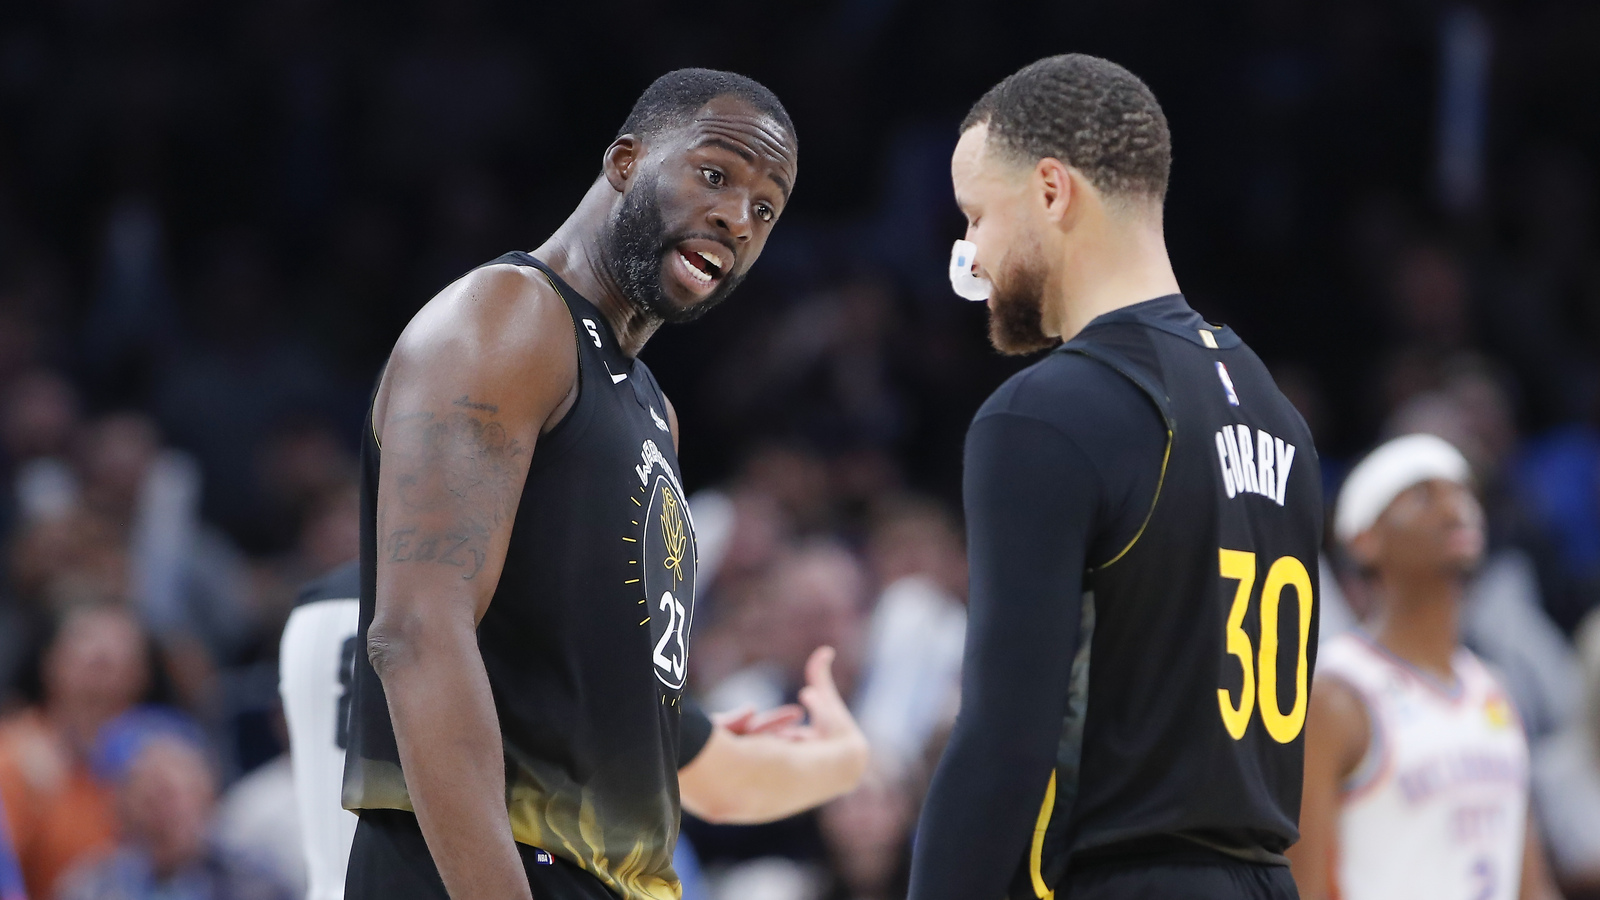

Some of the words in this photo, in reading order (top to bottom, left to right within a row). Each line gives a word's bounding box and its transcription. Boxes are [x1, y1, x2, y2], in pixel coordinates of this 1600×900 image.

[1215, 424, 1295, 506] CURRY
[653, 591, 685, 681] 23
[1217, 547, 1313, 744] 30
[537, 853, 548, 863] NBA
